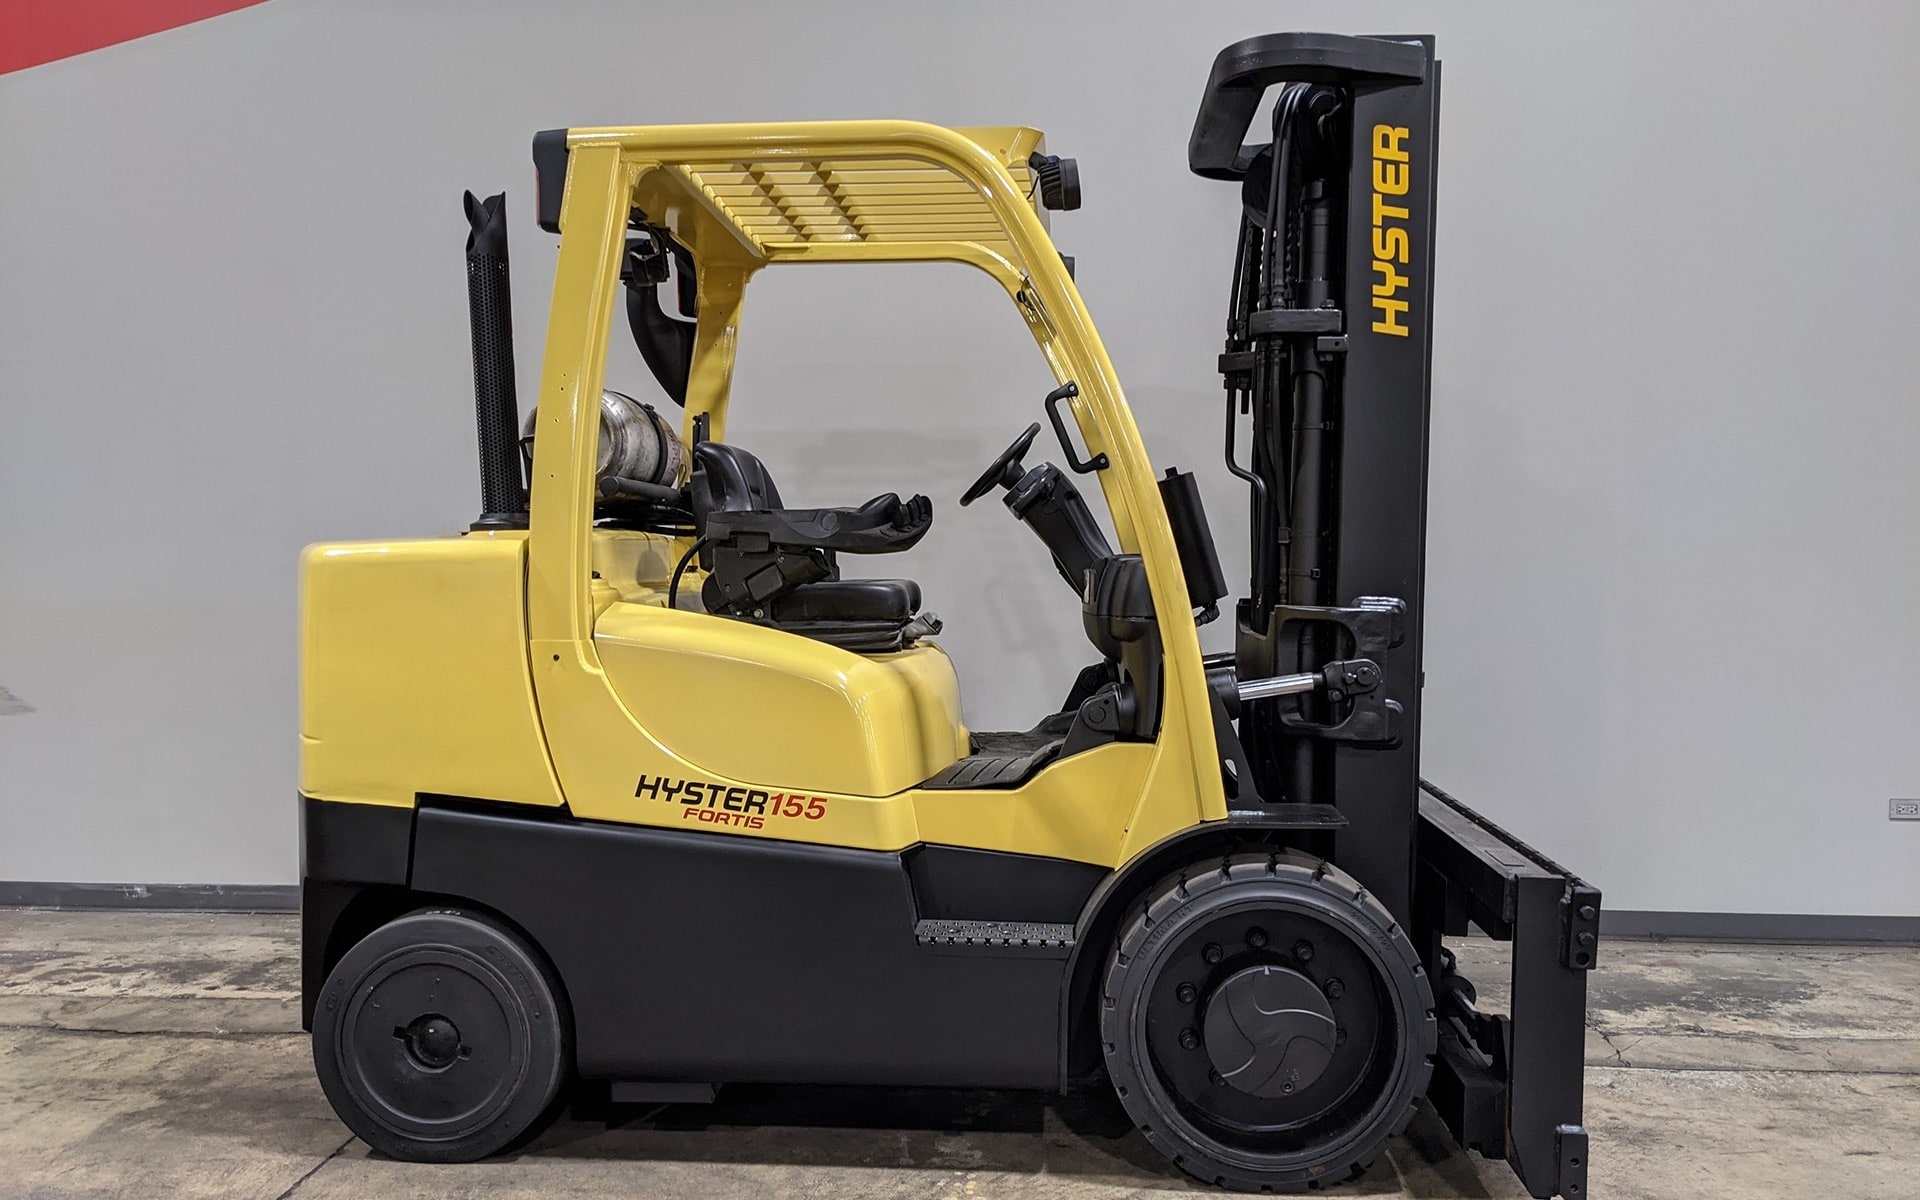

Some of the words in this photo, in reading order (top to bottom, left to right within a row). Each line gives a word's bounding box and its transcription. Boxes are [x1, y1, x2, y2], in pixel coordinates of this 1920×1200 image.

[1372, 124, 1409, 337] HYSTER
[635, 774, 769, 815] HYSTER
[770, 793, 828, 820] 155
[683, 807, 765, 829] FORTIS
